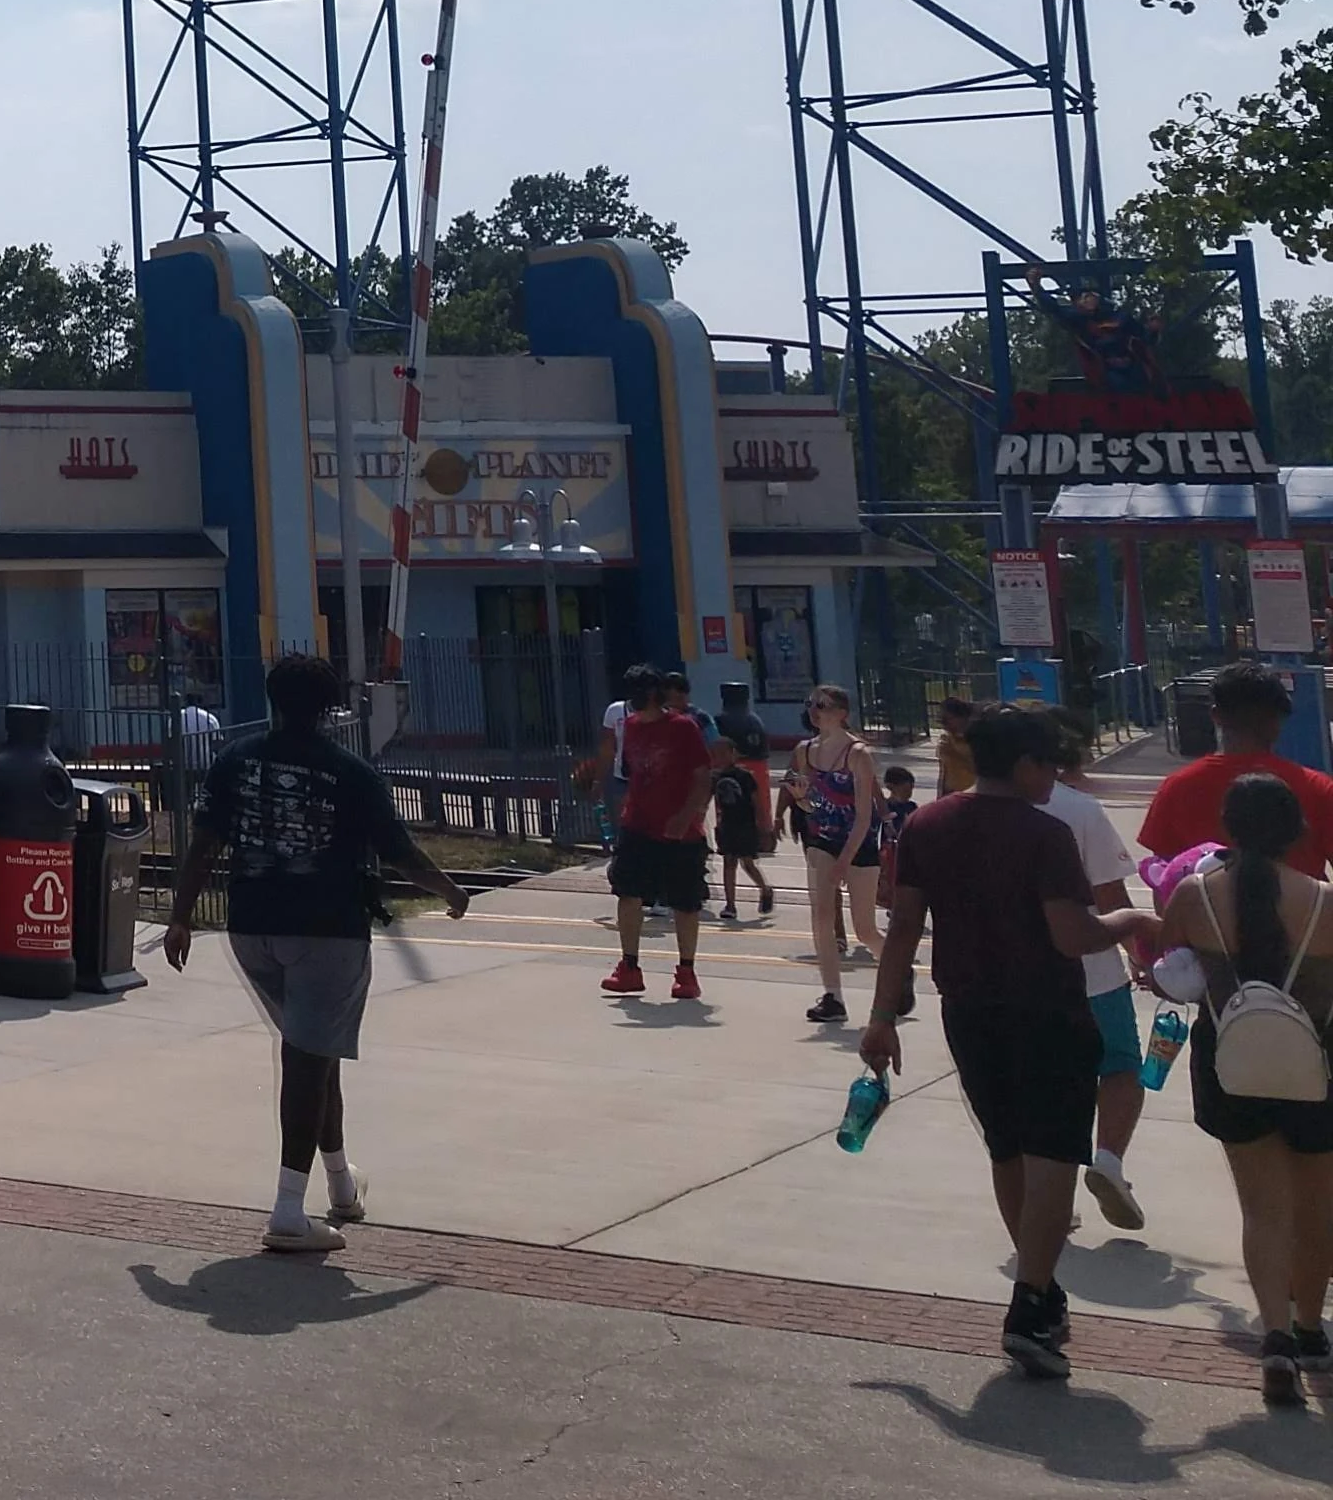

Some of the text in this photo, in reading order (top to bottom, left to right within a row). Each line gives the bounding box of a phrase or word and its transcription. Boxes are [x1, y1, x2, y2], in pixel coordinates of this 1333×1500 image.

[66, 437, 129, 467] HATS
[473, 451, 612, 478] PLANET
[733, 440, 812, 468] SHIRTS
[995, 431, 1279, 475] RIDE OF STEEL
[6, 855, 34, 865] Bottles
[35, 858, 50, 866] and
[20, 846, 47, 856] Please
[16, 922, 40, 934] give
[43, 922, 51, 934] it
